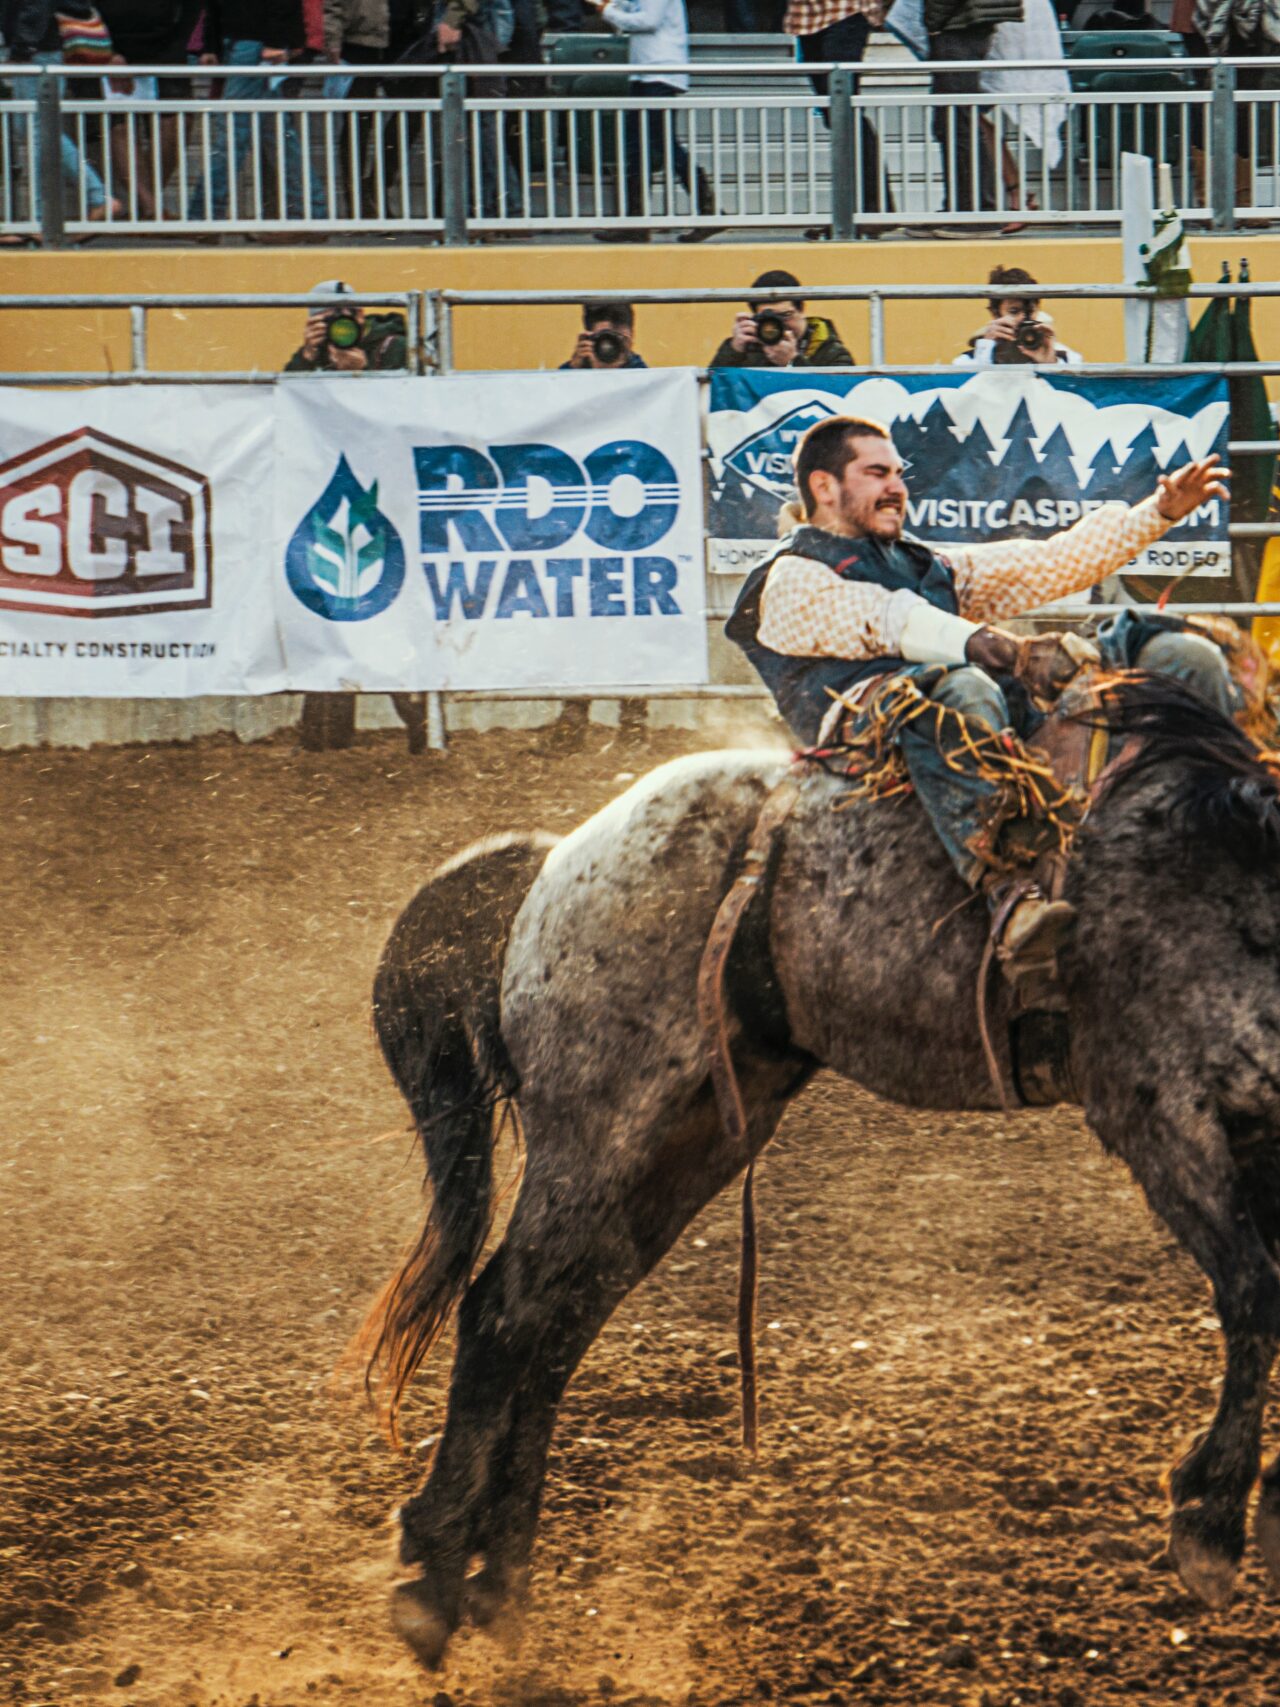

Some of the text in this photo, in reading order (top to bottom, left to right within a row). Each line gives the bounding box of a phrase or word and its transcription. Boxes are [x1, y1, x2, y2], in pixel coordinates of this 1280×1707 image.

[2, 469, 186, 580] SCI
[412, 440, 680, 552] RDO
[422, 556, 684, 620] WATER
[1148, 550, 1219, 566] RODEO
